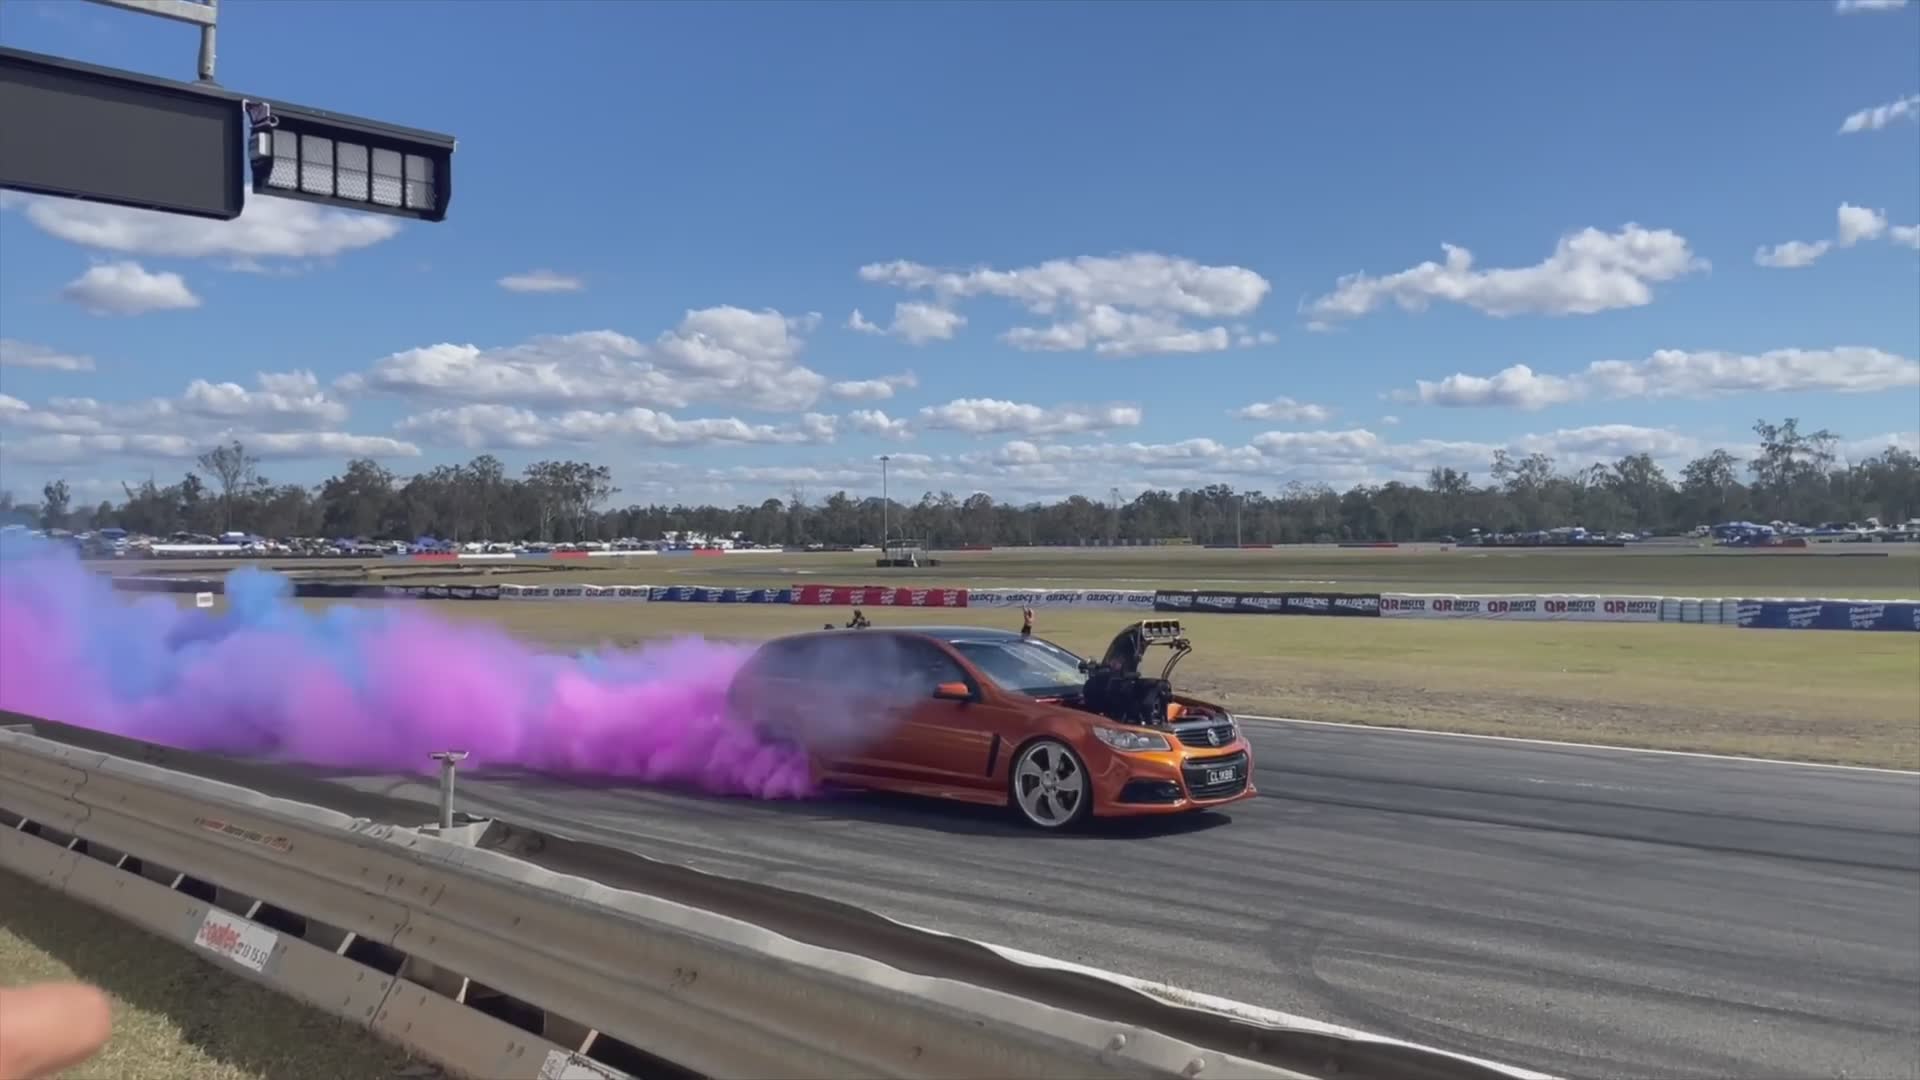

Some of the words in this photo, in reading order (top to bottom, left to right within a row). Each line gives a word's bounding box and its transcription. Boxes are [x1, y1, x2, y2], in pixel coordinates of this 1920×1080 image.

[1381, 599, 1399, 610] QR
[1432, 599, 1452, 611] QR
[1454, 600, 1480, 608] MOTO
[1488, 601, 1508, 612] QR
[1510, 600, 1536, 608] MOTO
[1544, 600, 1566, 612] QR
[1568, 600, 1595, 608] MOTO
[1604, 601, 1626, 613] QR
